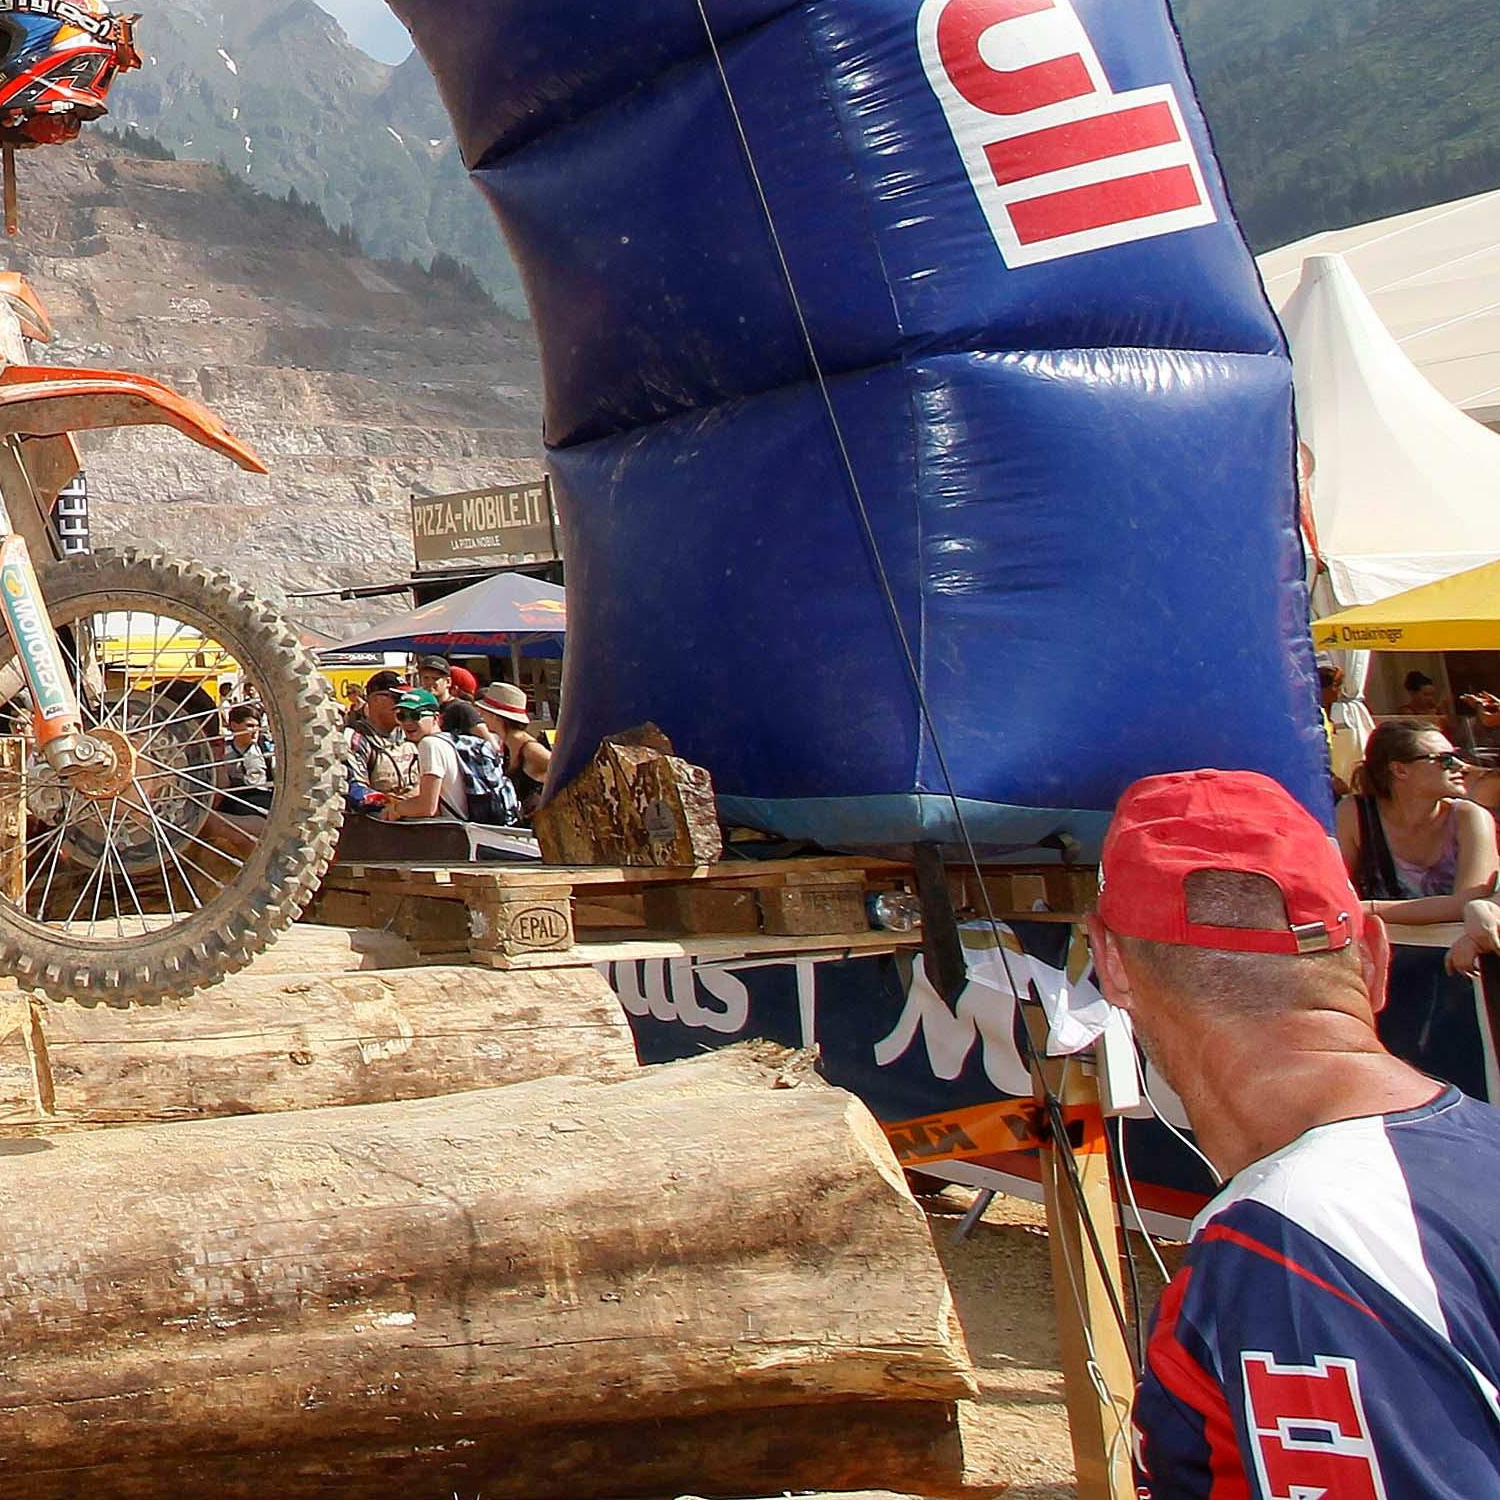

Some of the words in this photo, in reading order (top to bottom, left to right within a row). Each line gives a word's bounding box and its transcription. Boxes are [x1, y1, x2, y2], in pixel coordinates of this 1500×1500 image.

[413, 488, 543, 537] PIZZA-MOBILE.IT
[10, 600, 63, 700] MOTOREX
[517, 914, 561, 942] EPAL
